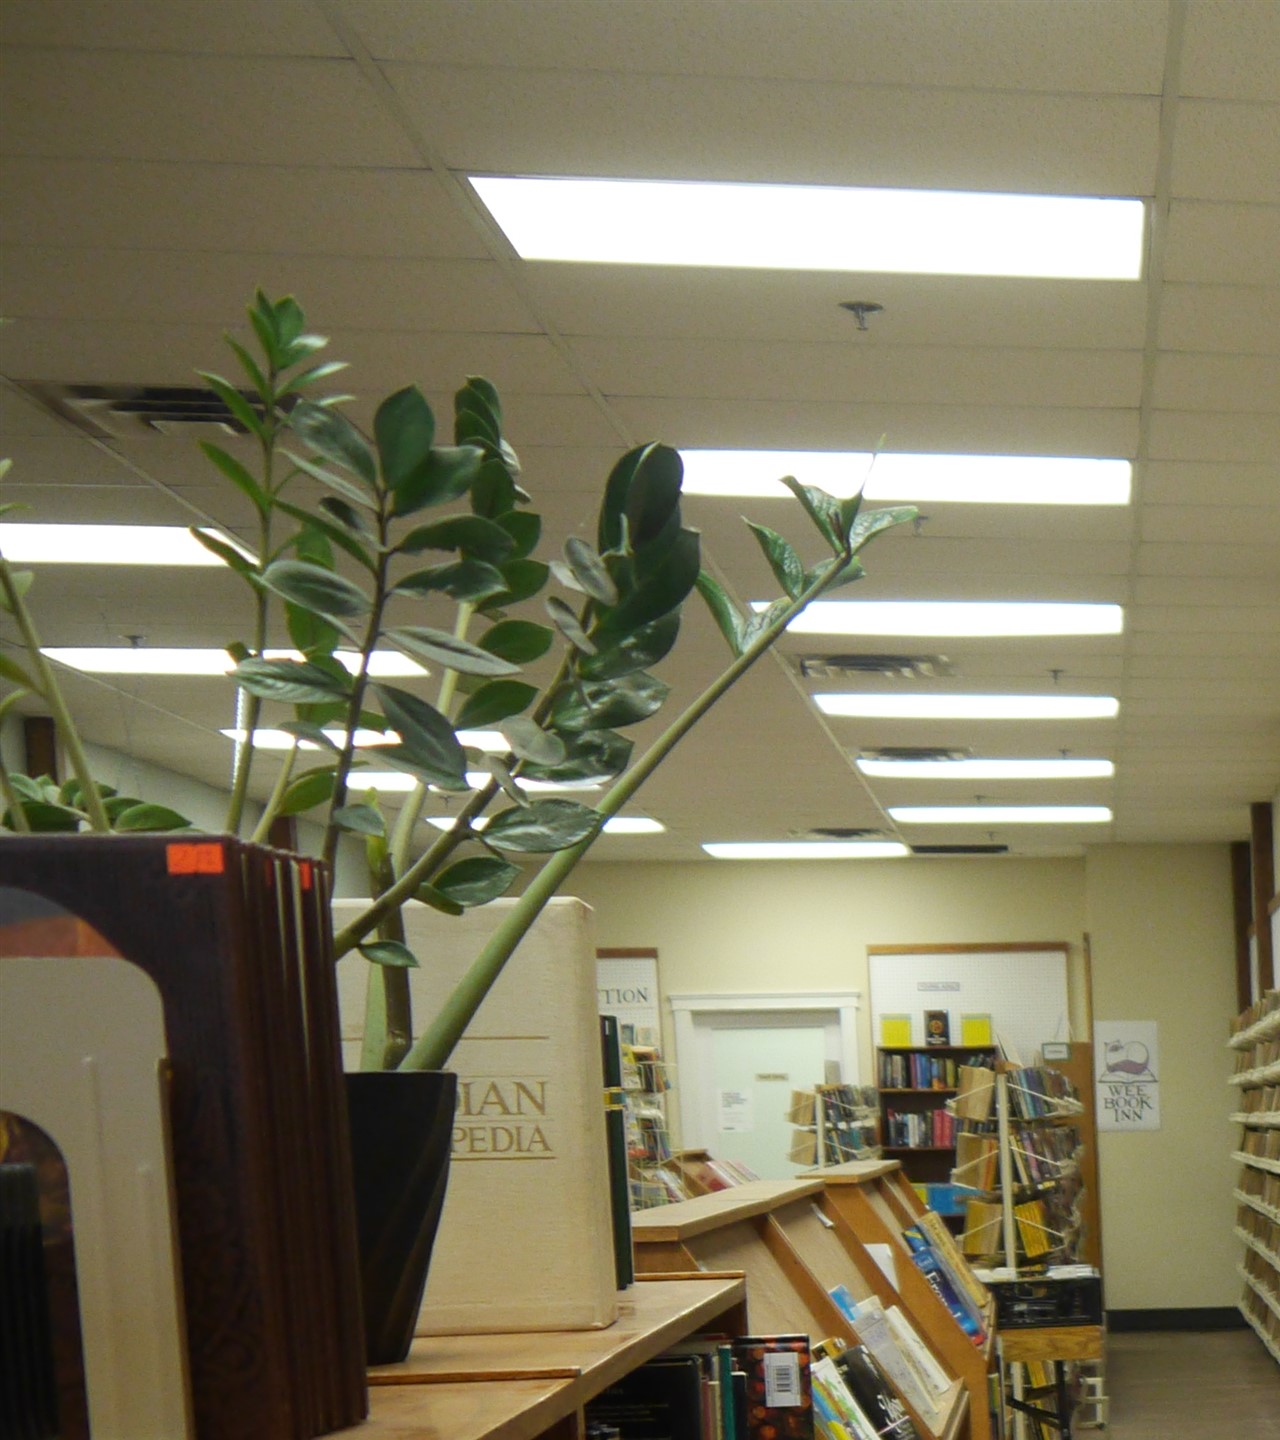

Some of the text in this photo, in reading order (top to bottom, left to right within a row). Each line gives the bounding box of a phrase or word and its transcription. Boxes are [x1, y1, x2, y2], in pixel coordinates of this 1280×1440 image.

[601, 987, 648, 1005] TION
[460, 1081, 548, 1117] IAN
[1108, 1085, 1147, 1097] WEE
[1104, 1096, 1153, 1111] BOOK
[1114, 1109, 1143, 1122] INN
[452, 1124, 553, 1154] PEDIA
